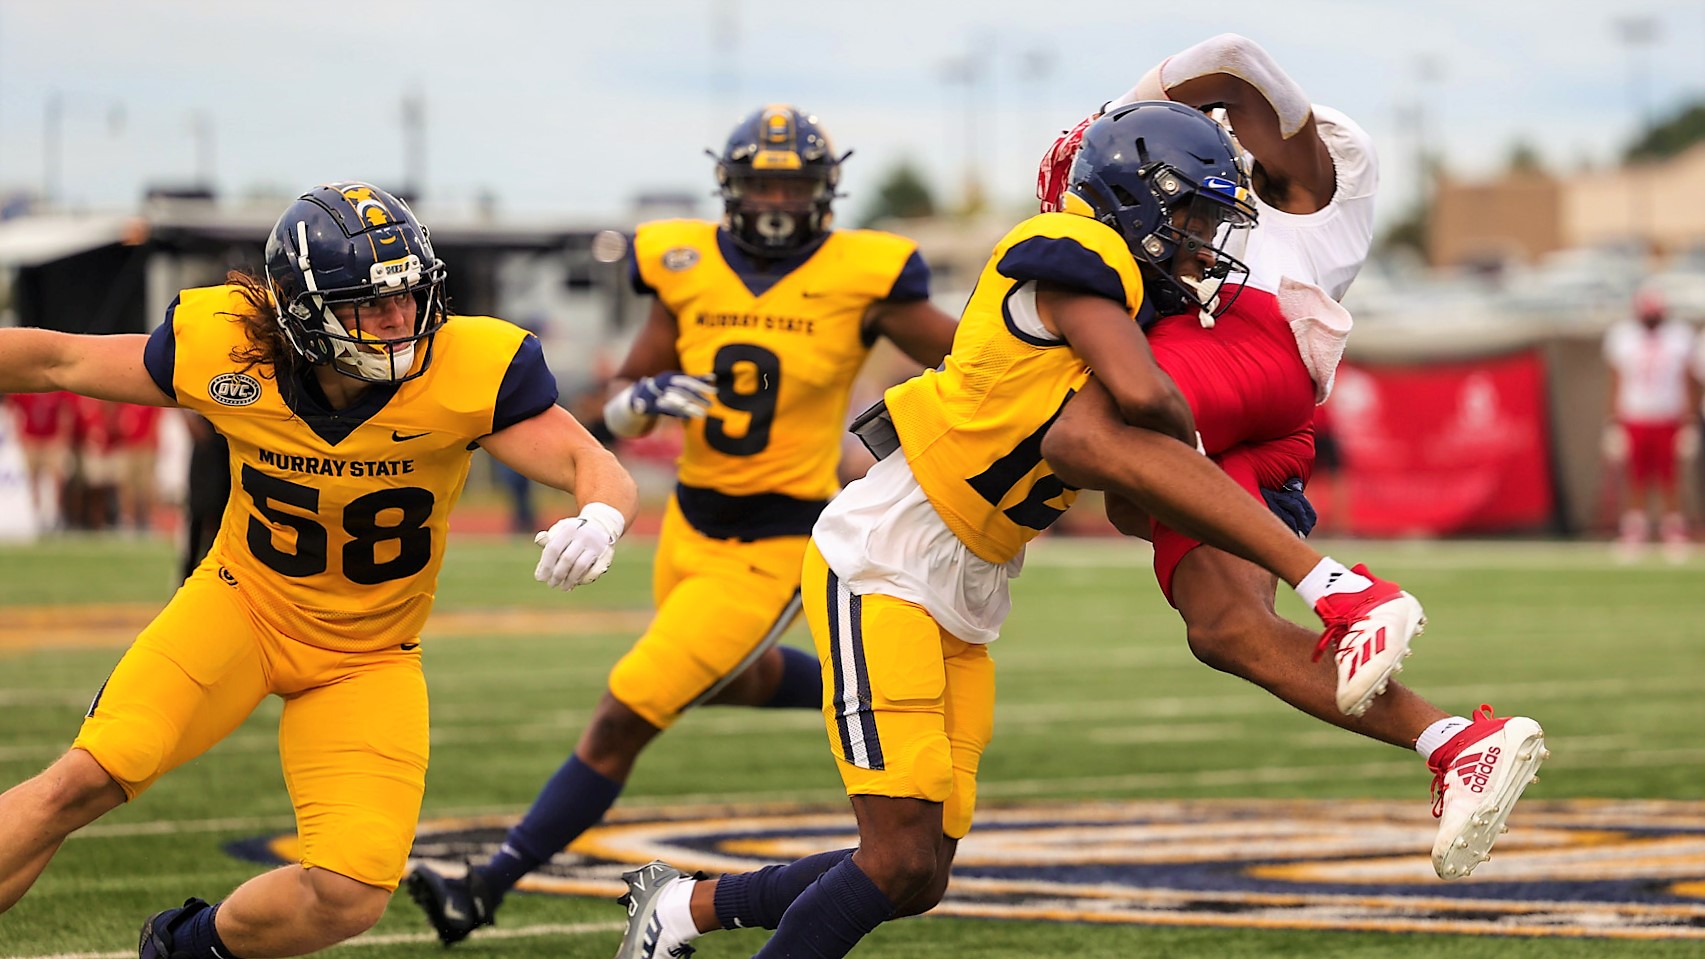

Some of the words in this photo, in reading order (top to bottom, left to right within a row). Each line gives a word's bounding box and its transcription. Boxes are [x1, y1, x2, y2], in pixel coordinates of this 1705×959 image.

[696, 312, 758, 328] MURRAY
[765, 316, 814, 335] STATE
[218, 382, 250, 397] OVC
[705, 343, 780, 457] 9
[258, 448, 347, 477] MURRAY
[350, 459, 415, 478] STATE
[241, 462, 435, 585] 58
[1470, 746, 1501, 794] adidas
